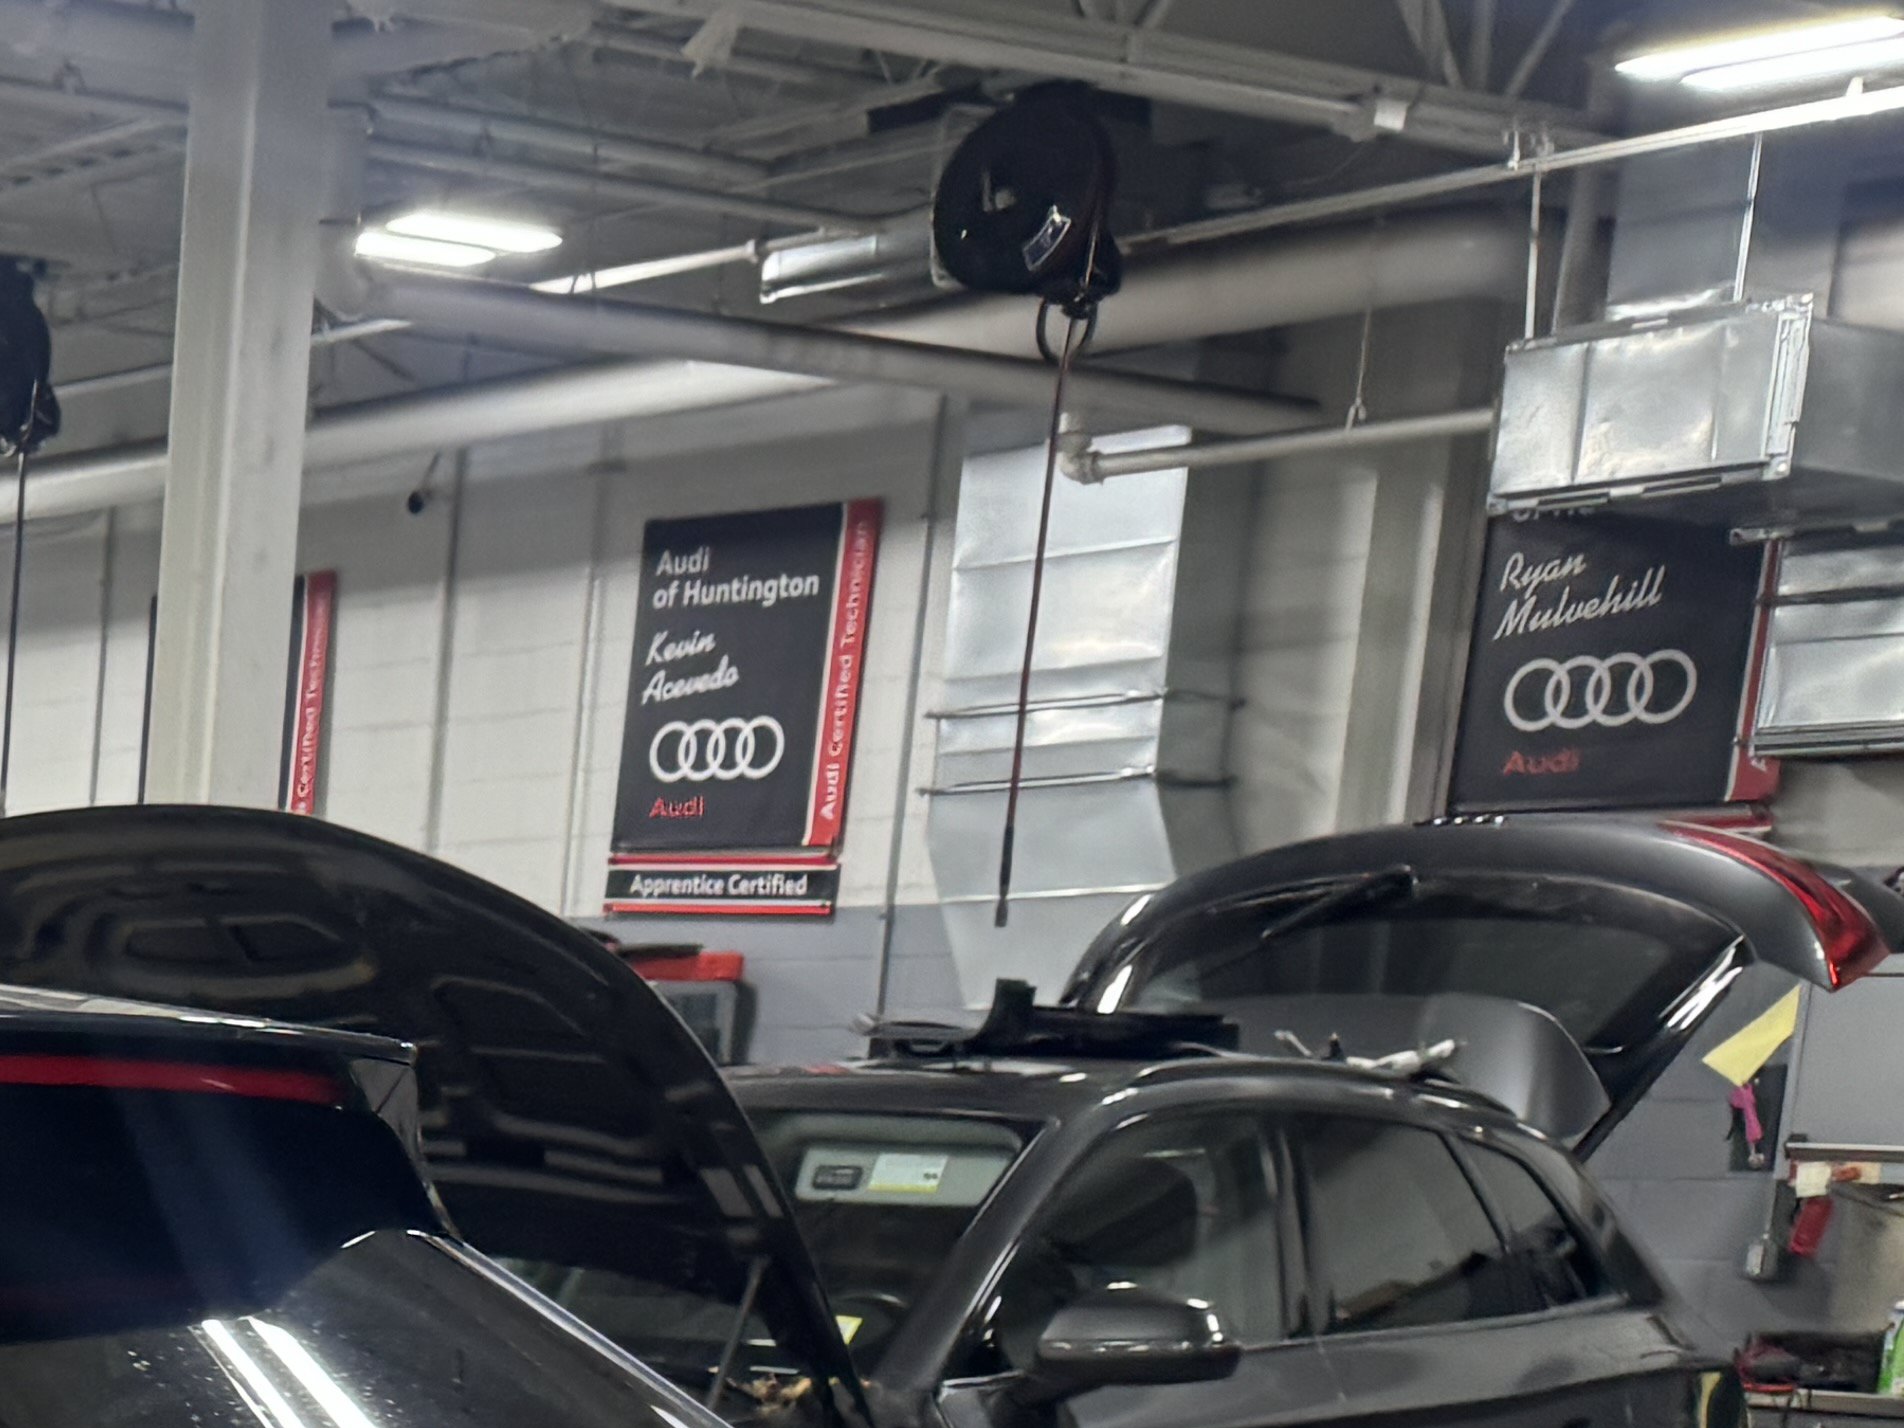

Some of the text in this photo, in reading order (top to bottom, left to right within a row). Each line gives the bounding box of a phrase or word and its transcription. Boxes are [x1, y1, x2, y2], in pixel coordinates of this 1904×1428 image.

[656, 546, 710, 576] Audi
[1500, 551, 1587, 599] Ryan
[653, 572, 819, 609] of Huntington
[1493, 564, 1666, 641] Mulvehill
[644, 631, 716, 665] Kevin
[641, 655, 739, 705] Acevedo
[819, 520, 869, 820] Audi Certified Technician
[1503, 745, 1581, 776] Audi
[649, 796, 705, 818] Audi
[629, 872, 808, 899] Apprentice Certified
